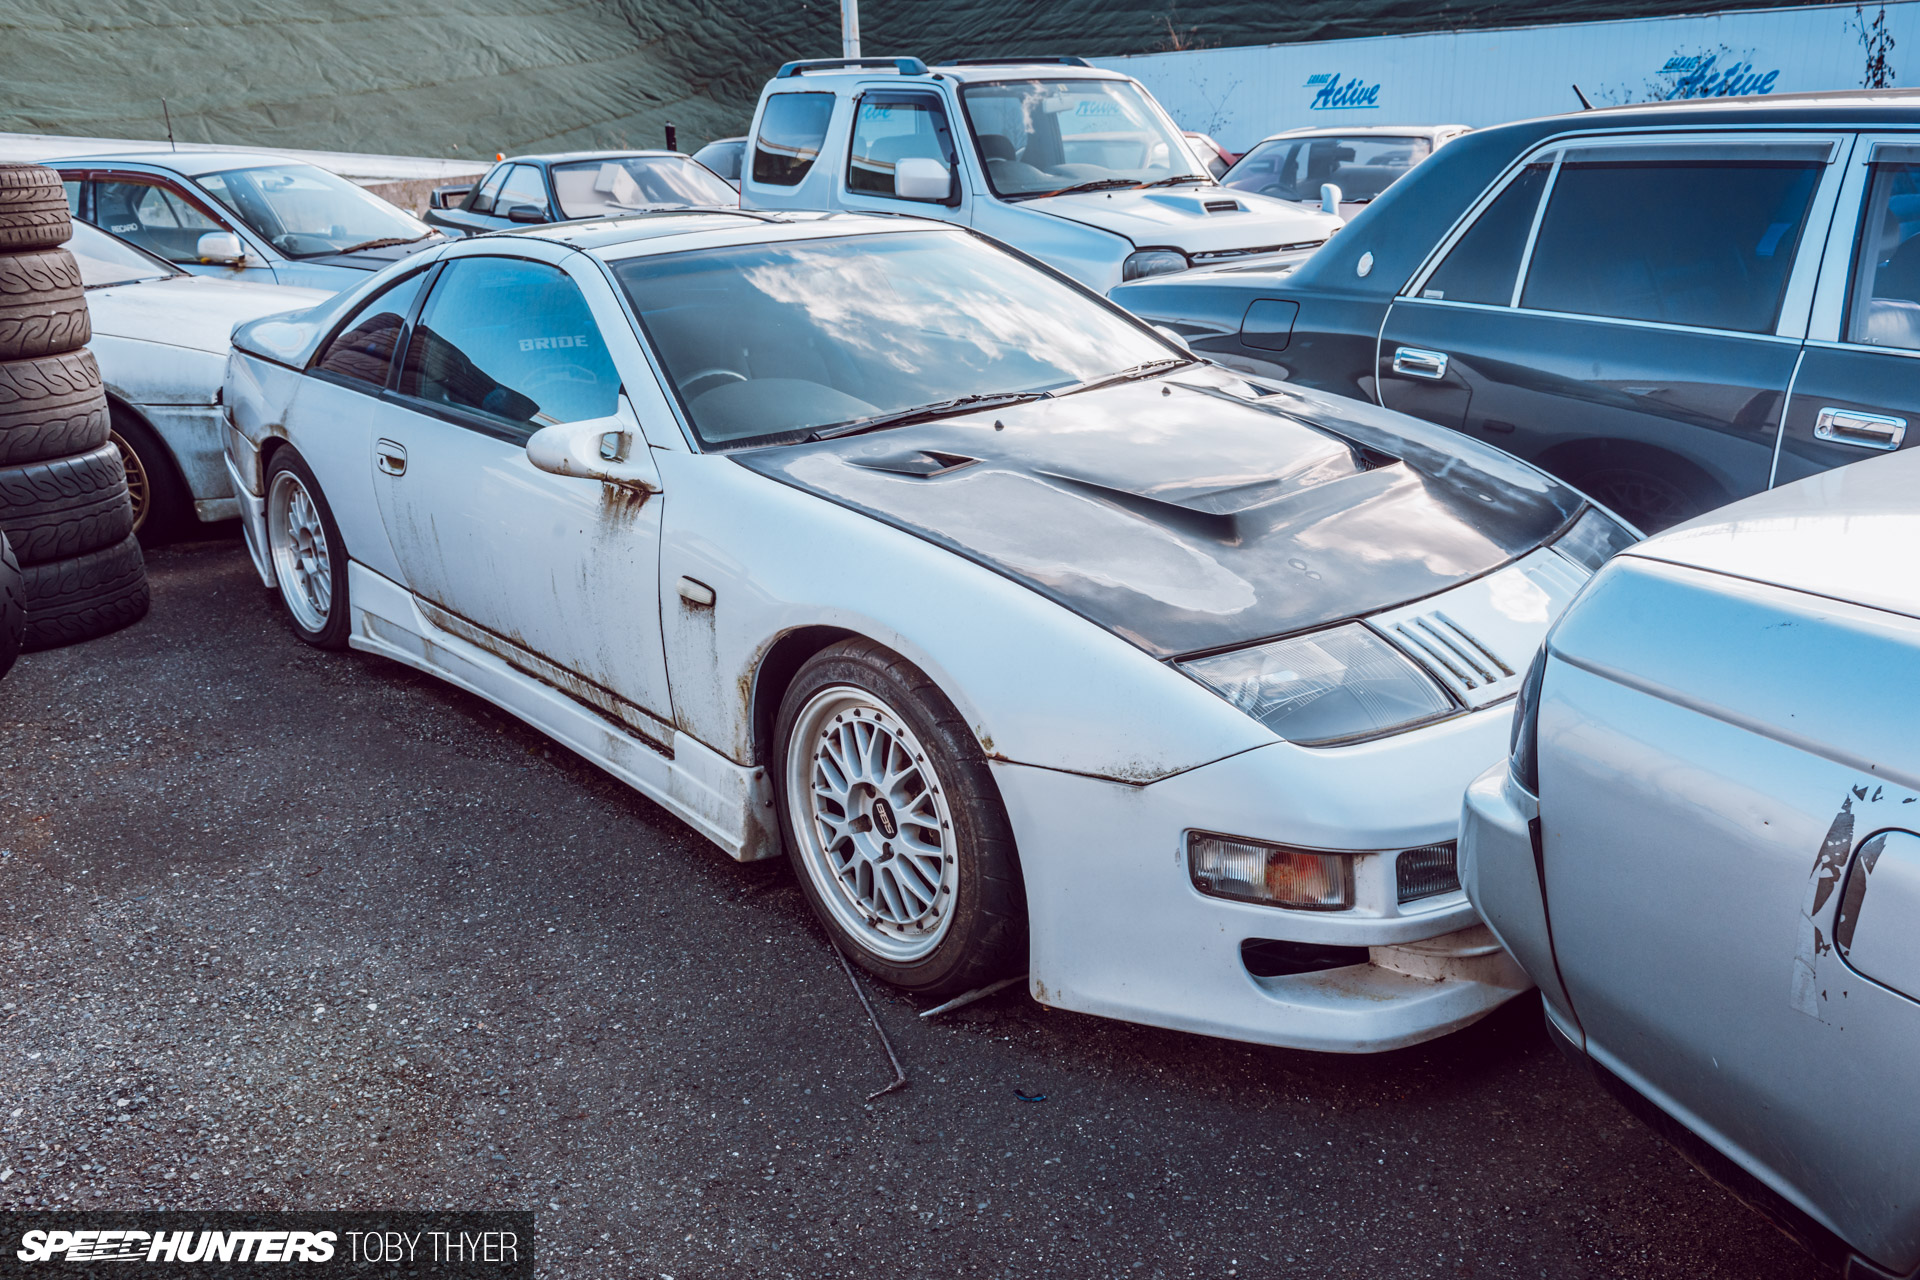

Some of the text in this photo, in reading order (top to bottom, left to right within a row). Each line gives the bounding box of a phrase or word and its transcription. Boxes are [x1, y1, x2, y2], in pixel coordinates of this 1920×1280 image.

[1310, 73, 1380, 108] Active
[1665, 55, 1780, 100] Active
[111, 223, 138, 233] RECARO
[518, 335, 588, 352] BRIDE
[876, 803, 895, 834] BBS
